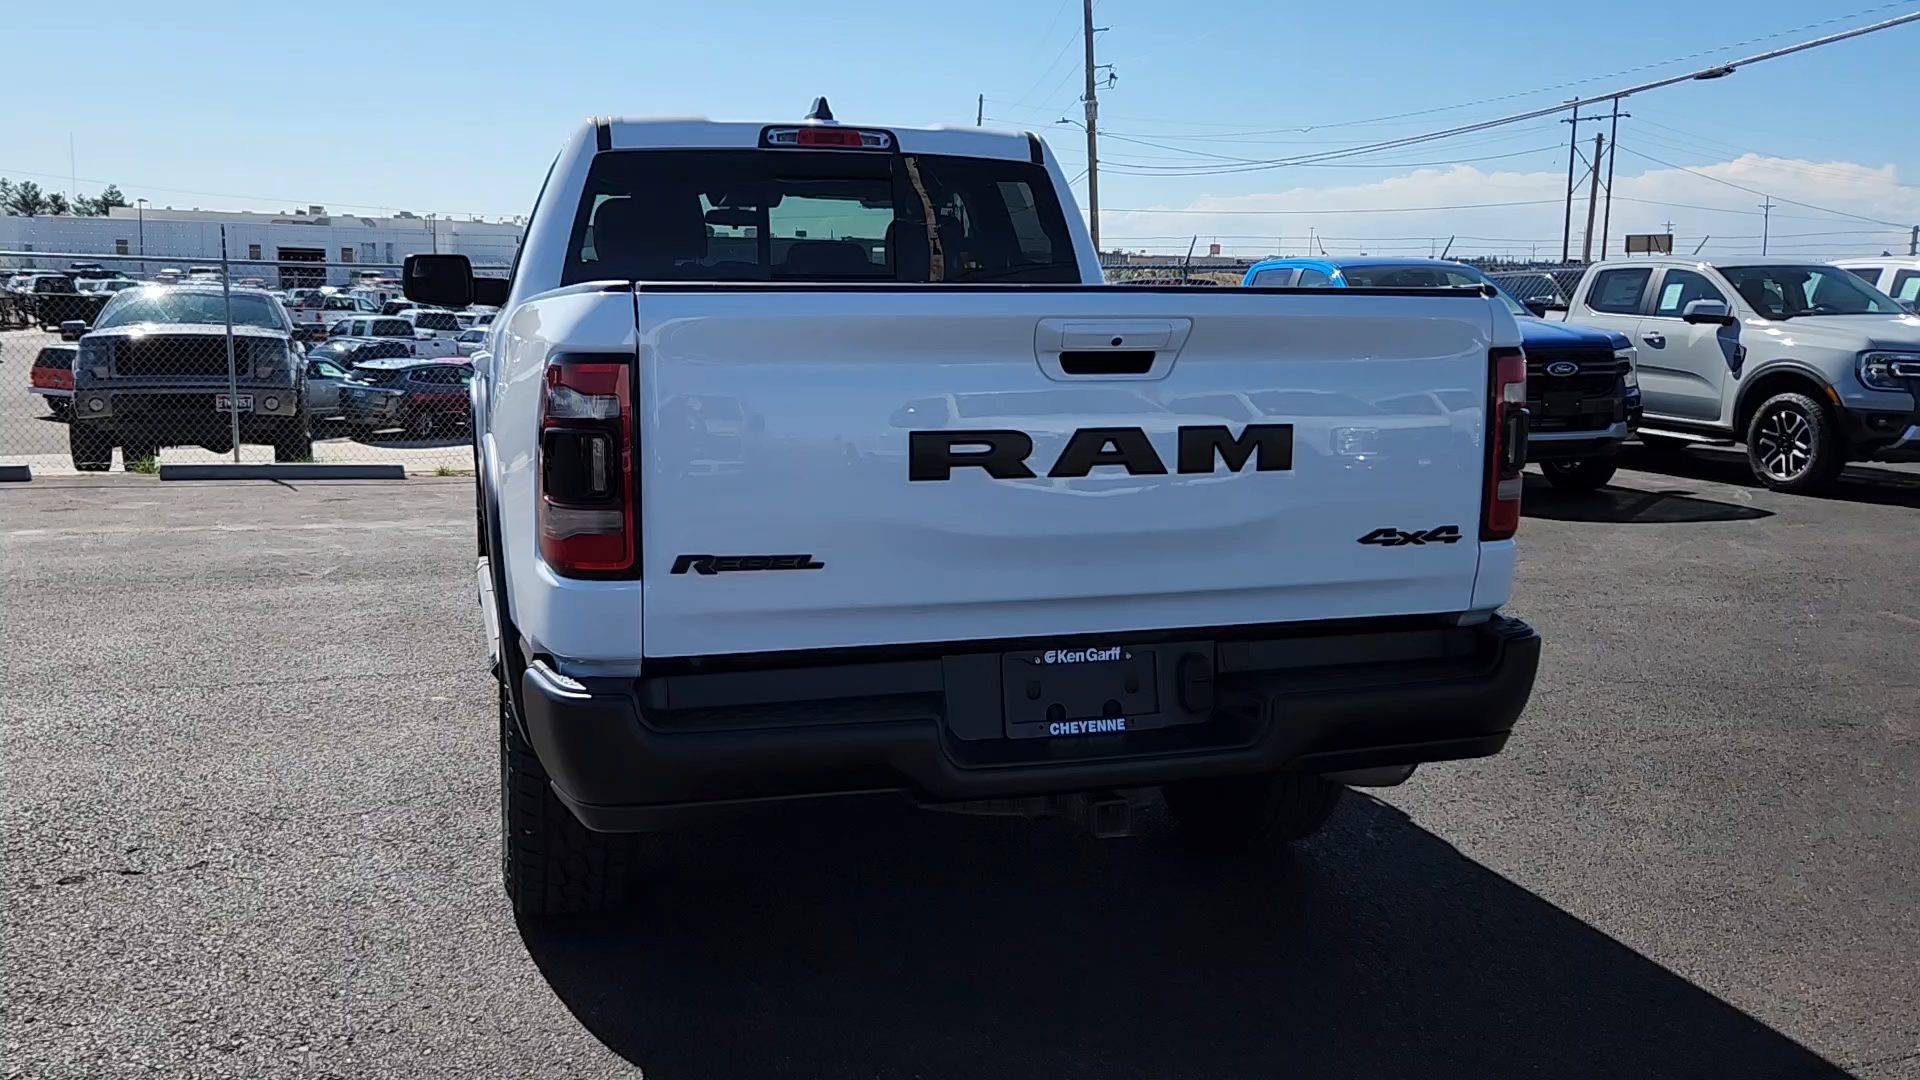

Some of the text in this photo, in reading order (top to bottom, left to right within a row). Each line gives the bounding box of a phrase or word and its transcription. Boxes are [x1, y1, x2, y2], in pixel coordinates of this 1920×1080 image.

[909, 424, 1293, 481] RAM
[1356, 525, 1463, 546] 4x4
[1057, 646, 1121, 664] Ken Garff
[1049, 718, 1126, 736] CHEYENNE
